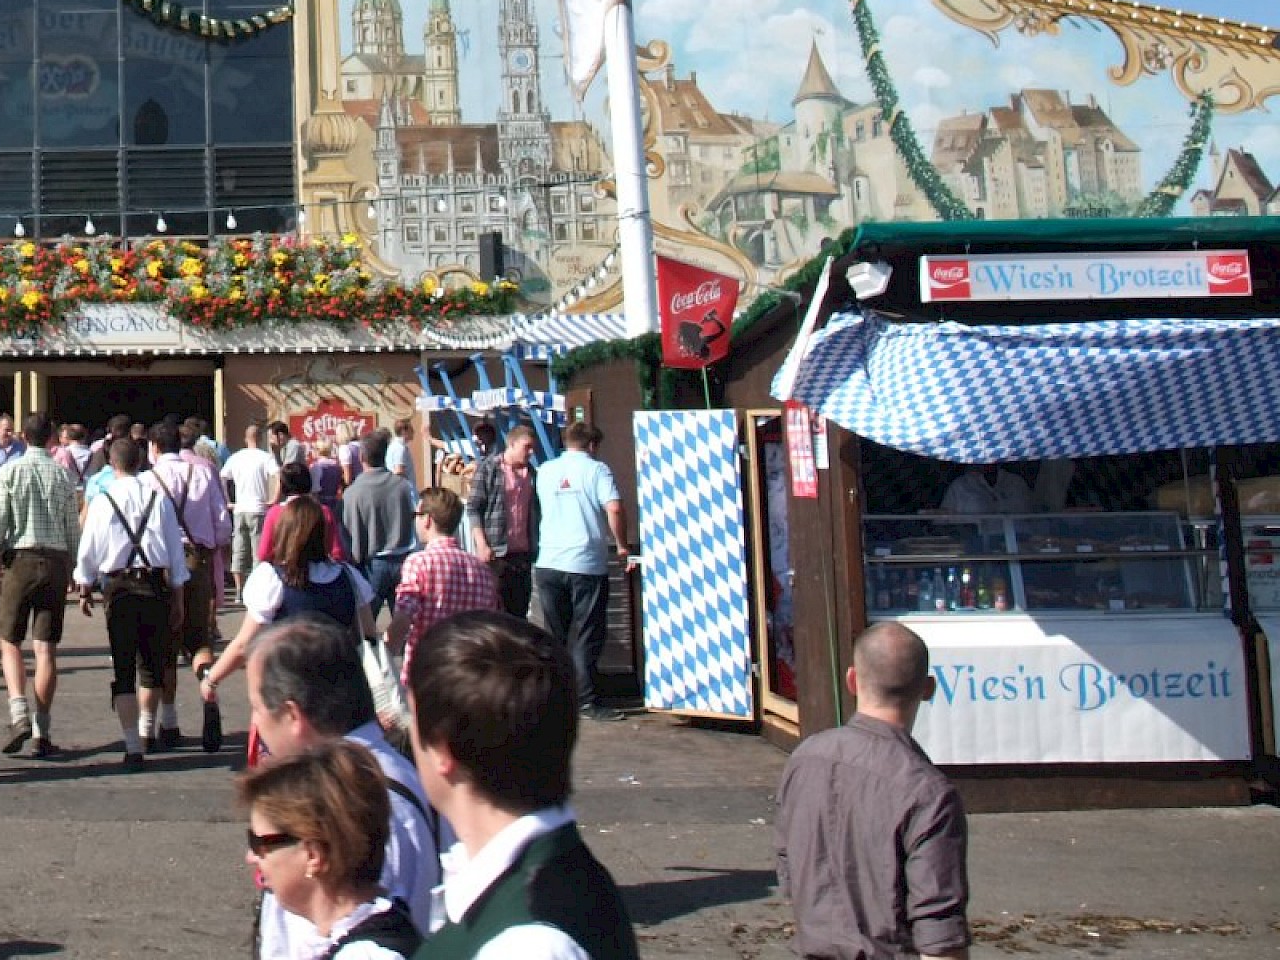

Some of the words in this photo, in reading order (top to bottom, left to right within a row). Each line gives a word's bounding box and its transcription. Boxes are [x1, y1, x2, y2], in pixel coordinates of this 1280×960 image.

[974, 264, 1074, 292] Wies'n
[1086, 261, 1202, 295] Brotzeit
[671, 279, 721, 314] Coca-Cola
[1059, 661, 1232, 711] Brotzeit
